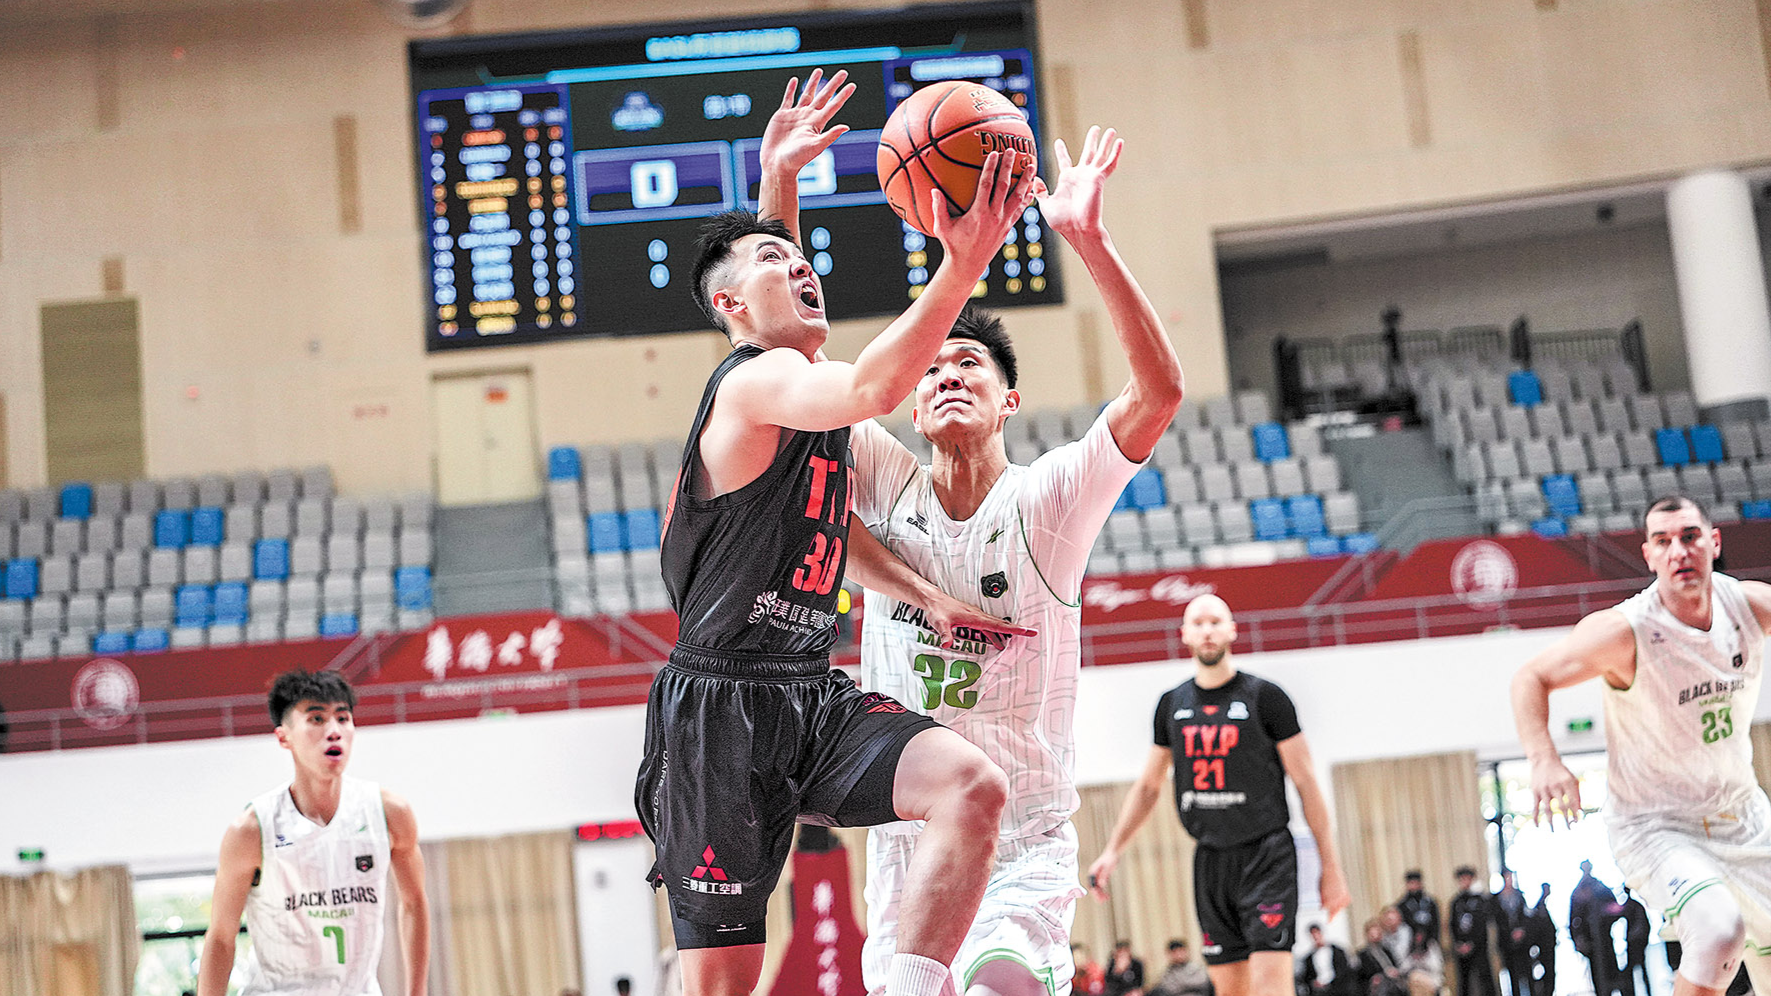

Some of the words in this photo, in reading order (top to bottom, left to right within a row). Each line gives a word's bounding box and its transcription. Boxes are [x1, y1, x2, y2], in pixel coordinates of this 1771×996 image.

[630, 160, 679, 209] 0
[792, 532, 843, 596] 30
[891, 600, 940, 636] BLAC
[914, 653, 982, 710] 32
[1679, 680, 1711, 705] BLACK
[1701, 706, 1733, 743] 23
[1192, 758, 1225, 790] 21
[285, 892, 327, 910] BLACK
[331, 886, 378, 905] BEARS
[323, 925, 345, 964] 7
